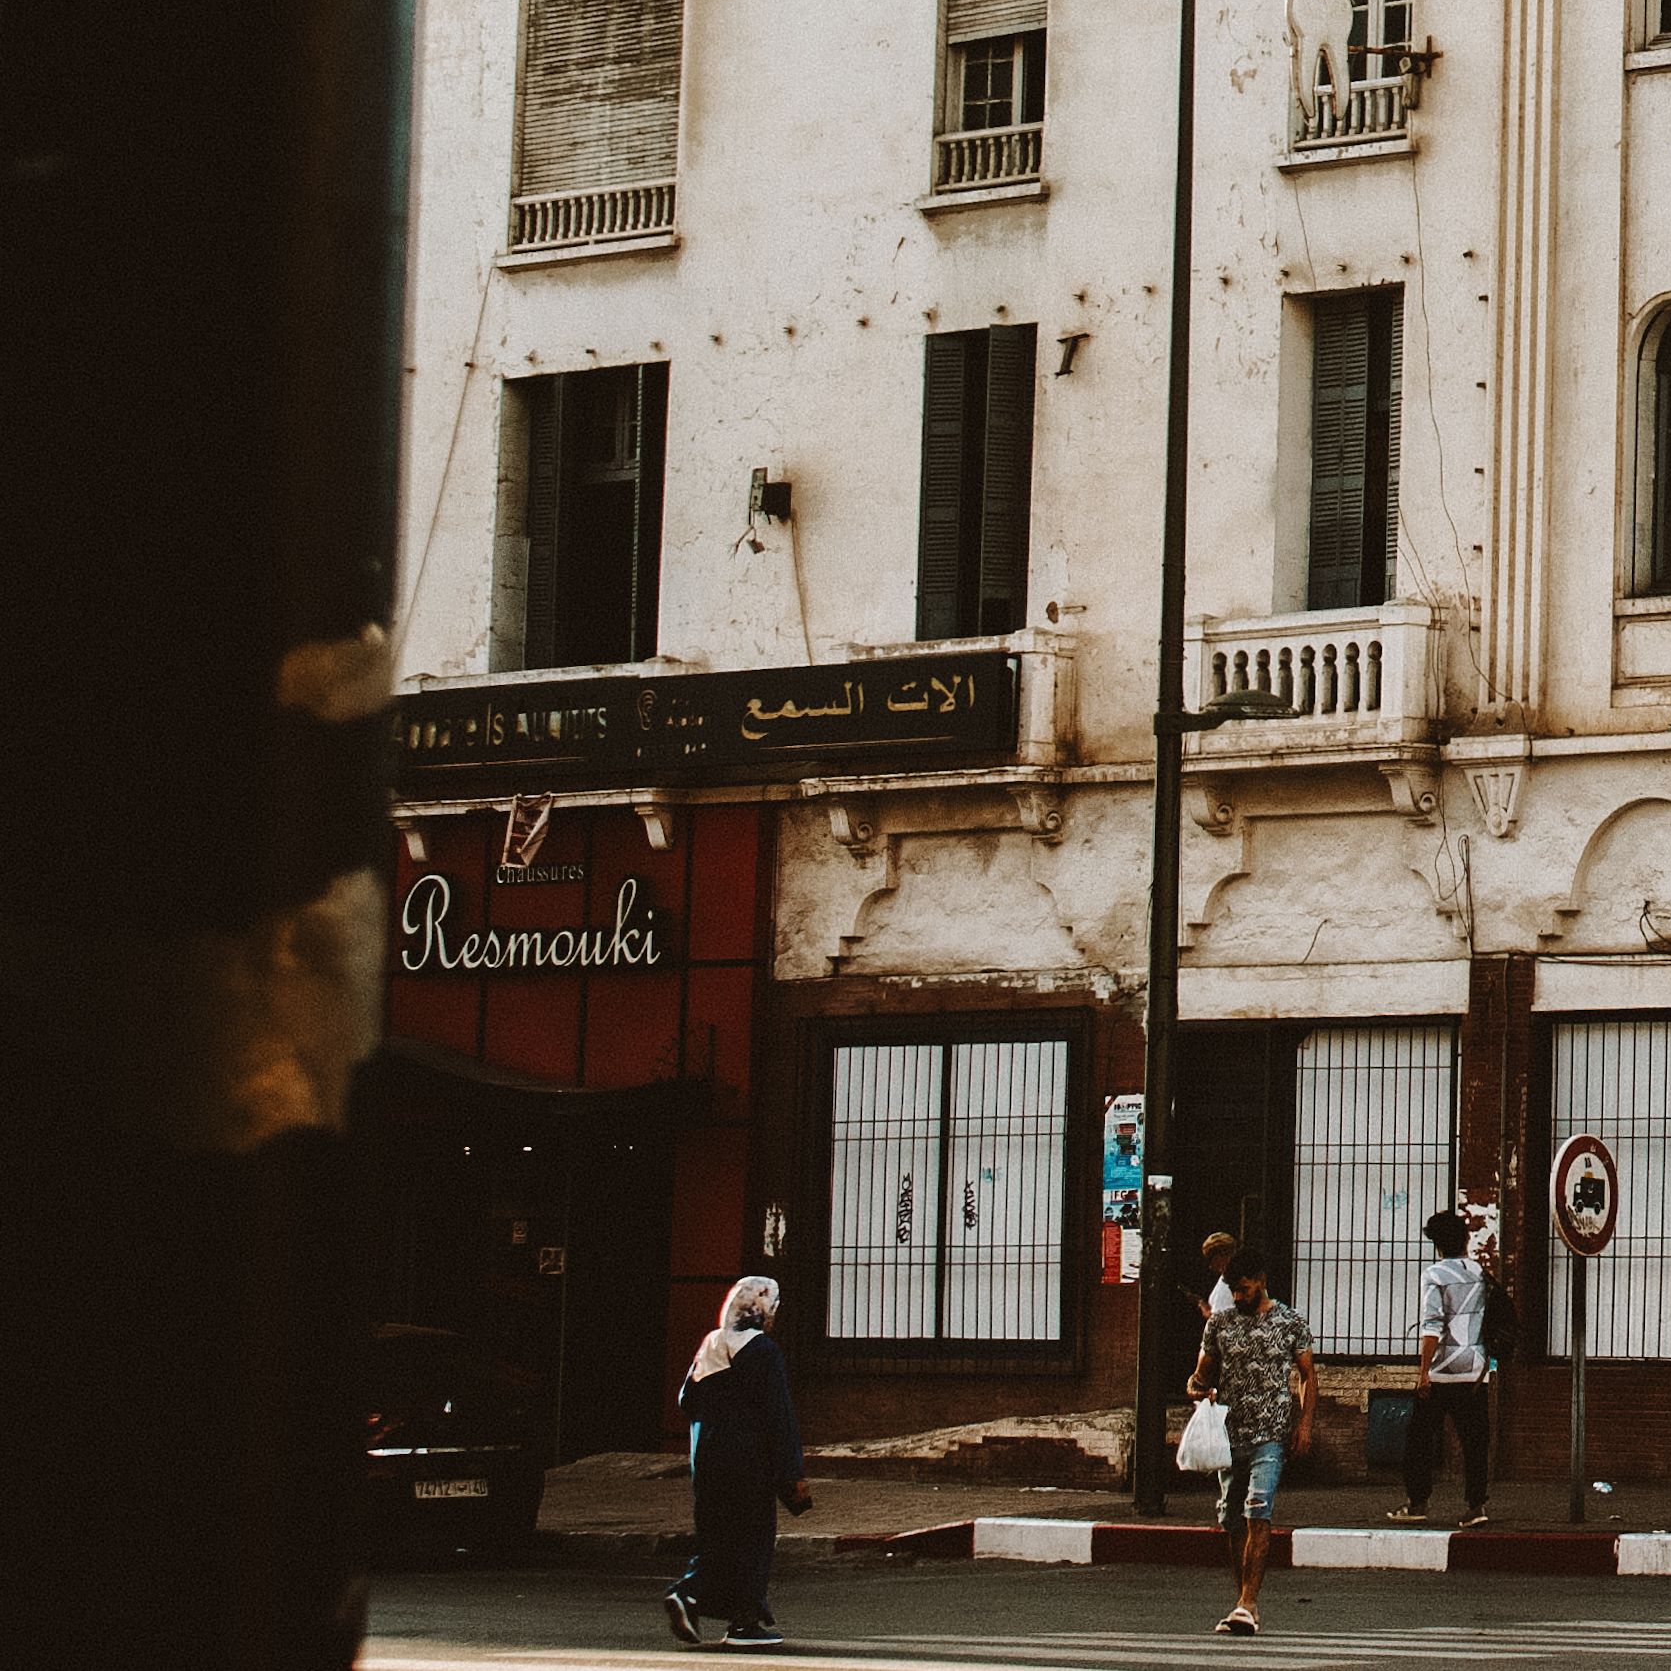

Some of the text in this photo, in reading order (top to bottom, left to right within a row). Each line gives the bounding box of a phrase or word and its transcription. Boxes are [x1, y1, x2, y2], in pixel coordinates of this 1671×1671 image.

[740, 680, 866, 741] السمع
[496, 864, 585, 884] Chaussures
[401, 872, 663, 971] Resmouki
